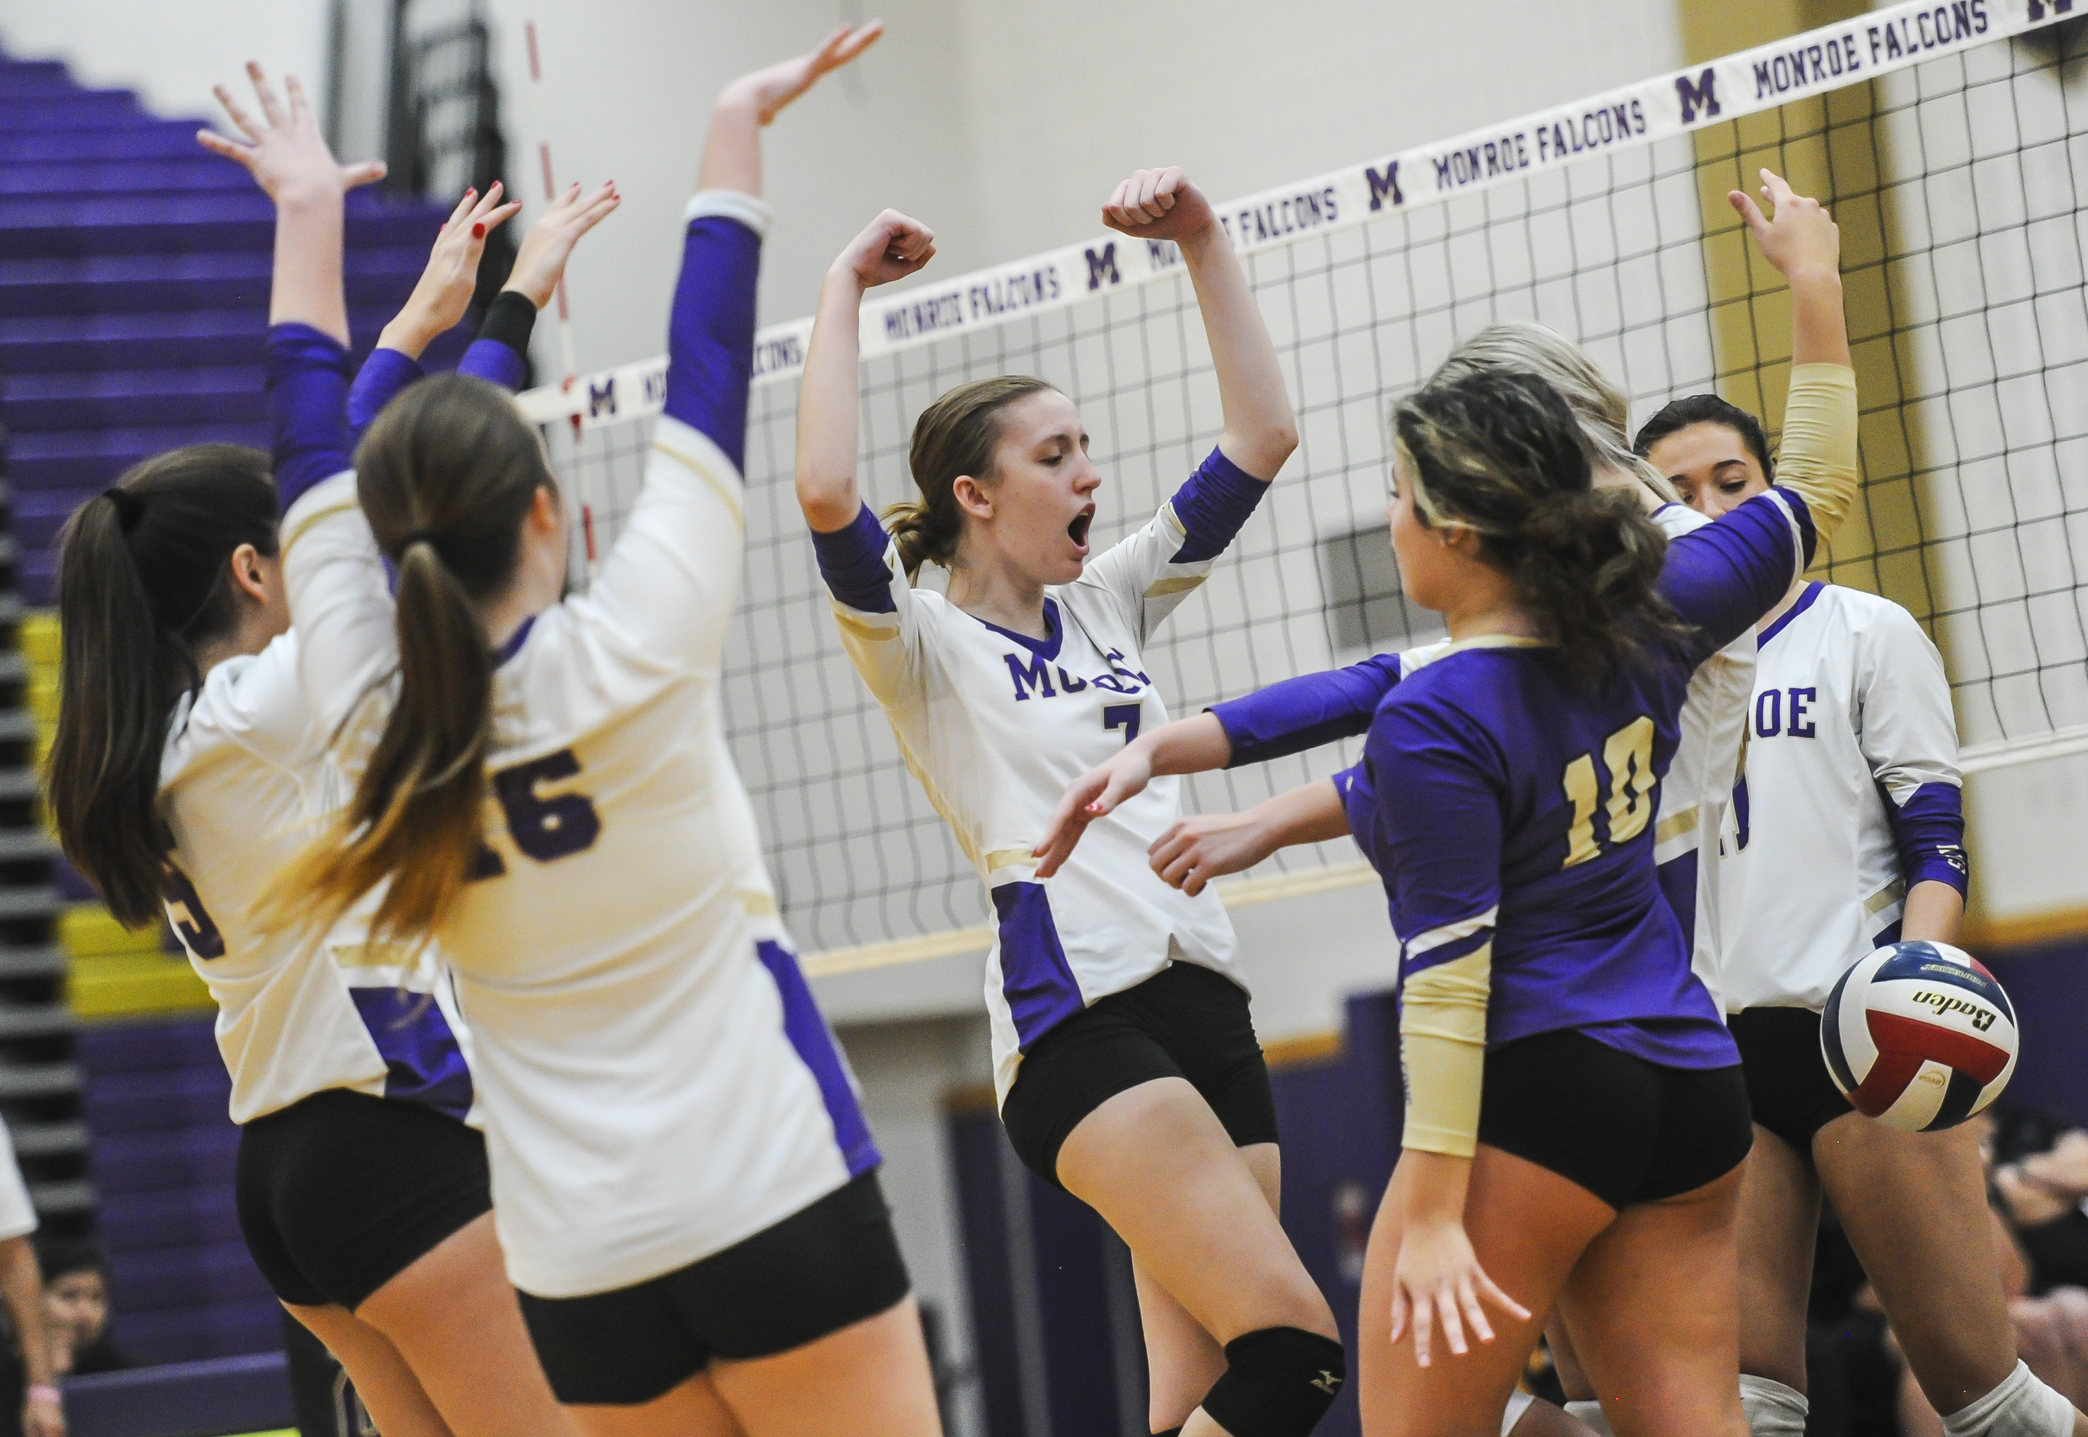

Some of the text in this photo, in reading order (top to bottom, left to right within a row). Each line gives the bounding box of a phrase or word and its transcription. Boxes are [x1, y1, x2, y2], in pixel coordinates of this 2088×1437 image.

[589, 378, 616, 418] M
[969, 265, 1061, 320] FALCONS
[1085, 242, 1120, 290] M
[1239, 187, 1338, 246] FALCONS
[1363, 160, 1404, 211] M
[1432, 133, 1529, 191] MONROE
[1537, 99, 1646, 162] FALCONS
[1674, 68, 1721, 125] M
[1753, 34, 1860, 99] MONROE
[1867, 0, 1988, 65] FALCONS
[1103, 700, 1143, 746] 7
[1562, 715, 1656, 869] 10
[1912, 990, 1997, 1032] Baden
